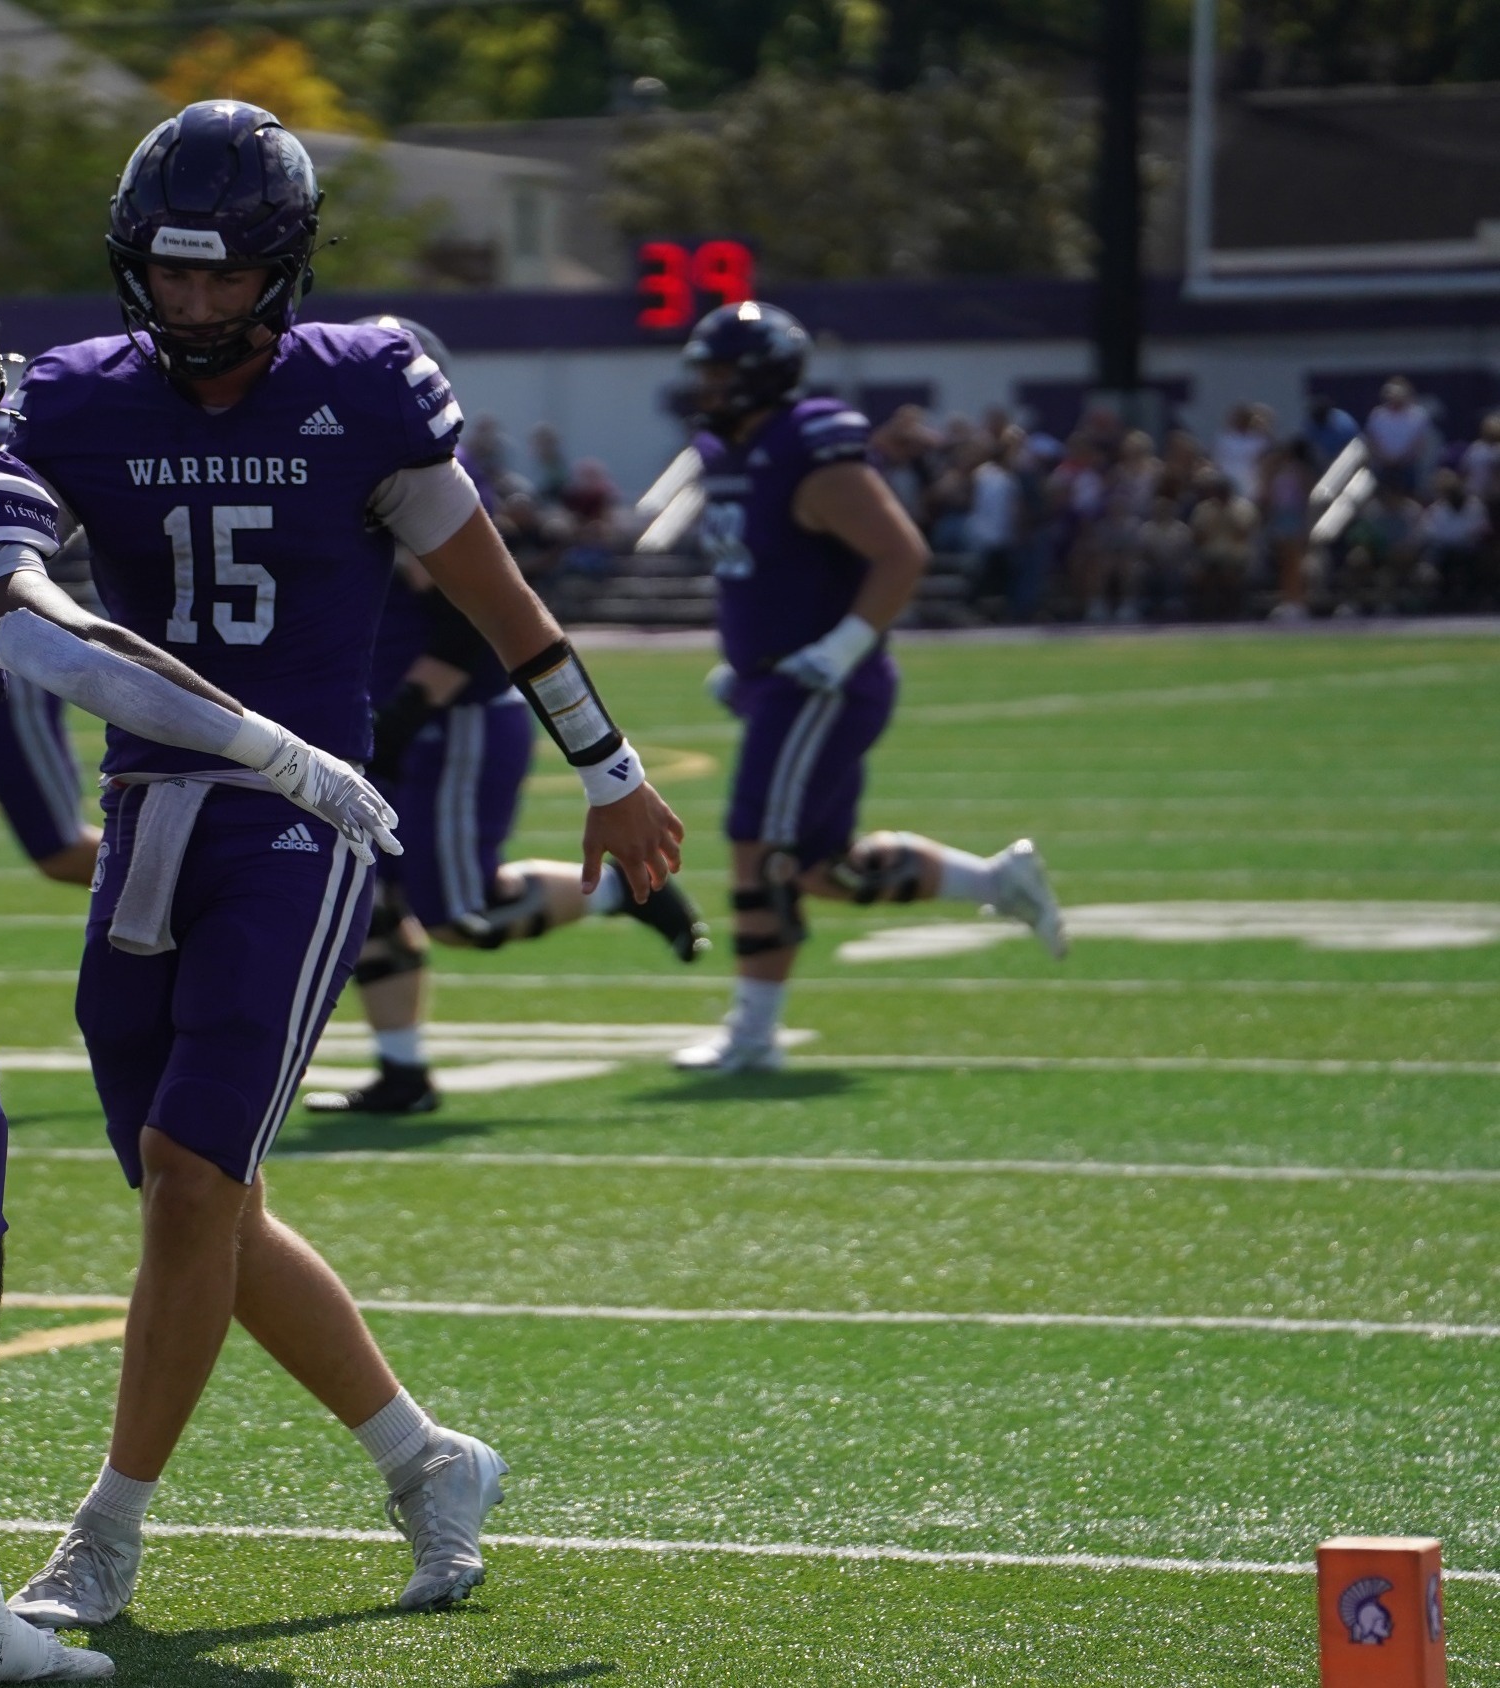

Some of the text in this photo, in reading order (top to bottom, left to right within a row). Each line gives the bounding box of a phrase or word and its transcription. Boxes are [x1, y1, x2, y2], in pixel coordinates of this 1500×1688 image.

[637, 241, 754, 327] 39
[299, 423, 344, 435] adidas
[126, 456, 308, 486] WARRIORS
[163, 505, 276, 645] 15
[271, 840, 320, 853] adidas
